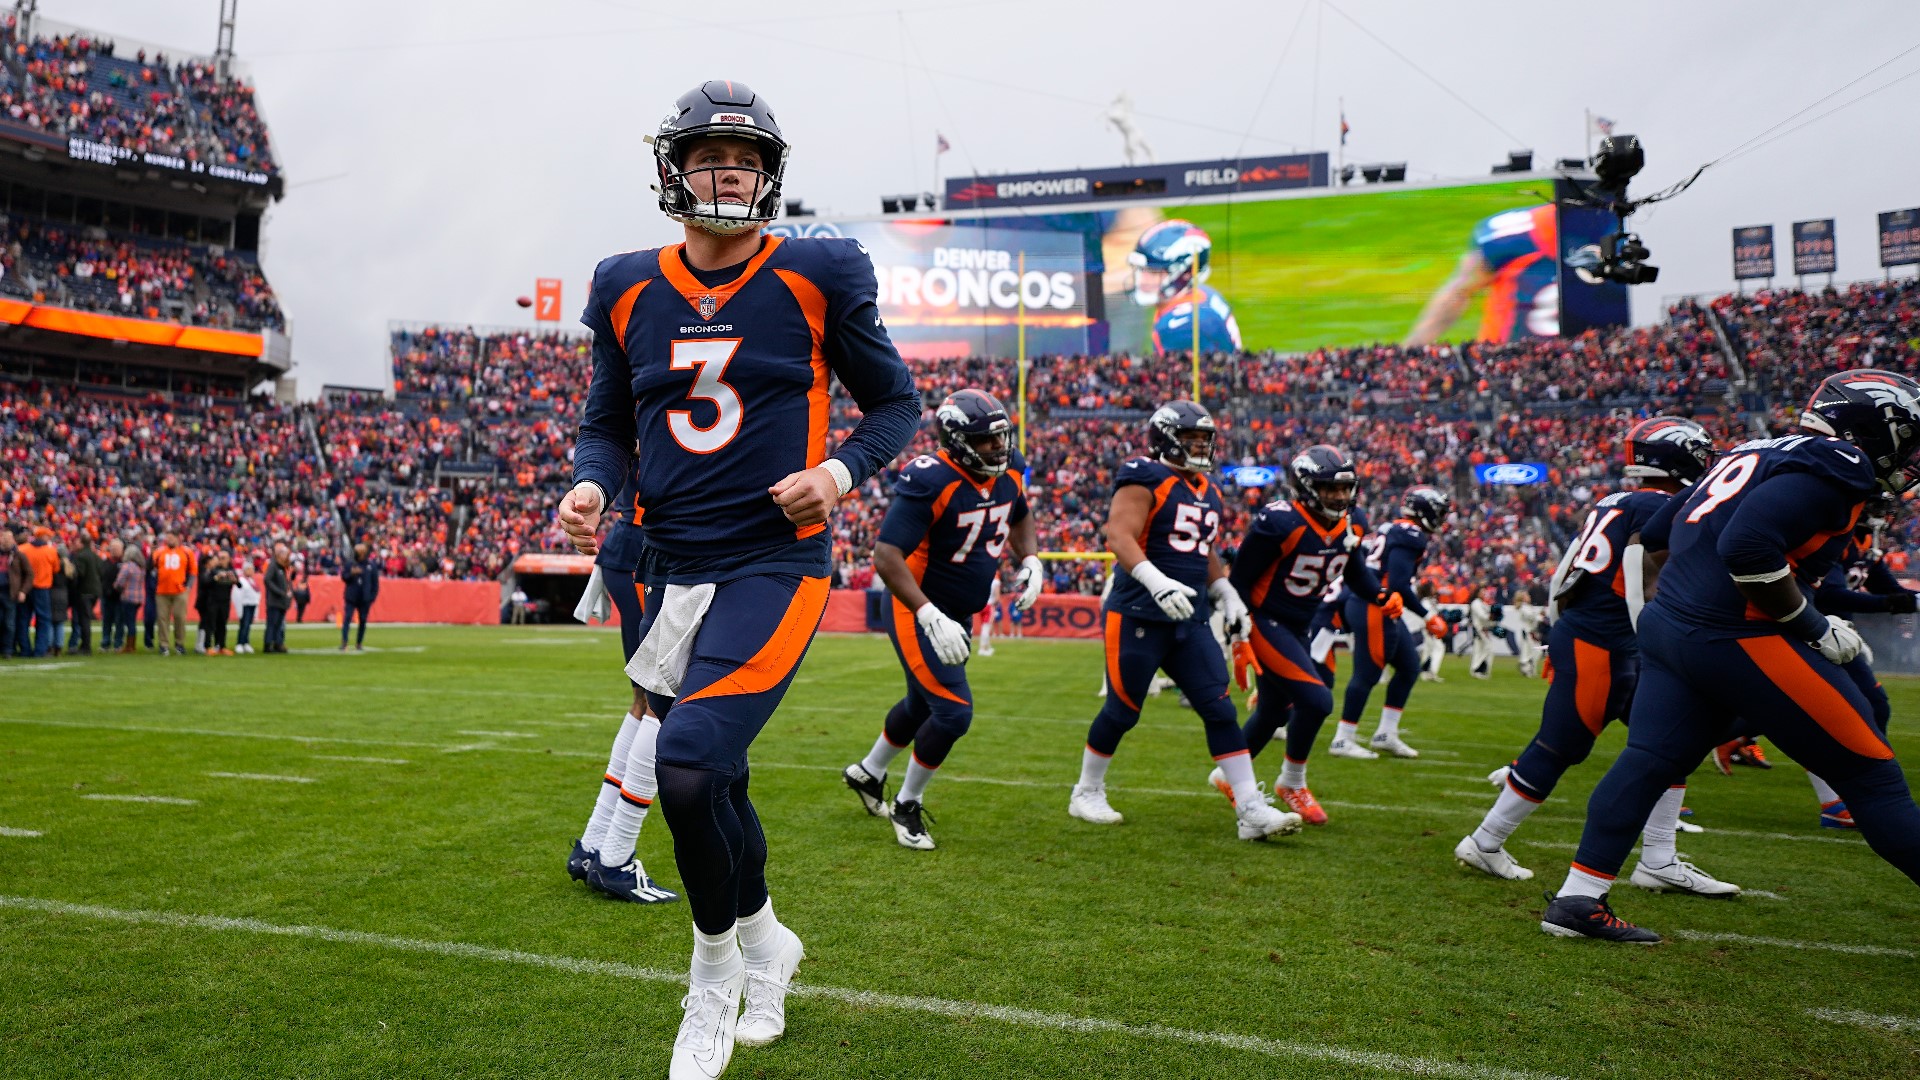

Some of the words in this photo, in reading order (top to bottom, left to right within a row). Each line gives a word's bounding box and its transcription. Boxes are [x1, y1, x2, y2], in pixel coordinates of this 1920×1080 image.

[720, 115, 746, 124] BRONCOS
[144, 152, 186, 170] NUMBER
[208, 164, 269, 186] COURTLAND
[998, 177, 1088, 199] EMPOWER
[1184, 165, 1239, 186] FIELD
[933, 247, 1011, 270] DENVER
[877, 265, 1076, 310] BRONCOS
[542, 295, 554, 315] 7
[680, 324, 733, 334] BRONCOS
[667, 337, 744, 454] 3
[951, 501, 1013, 563] 73
[1168, 503, 1219, 557] 52
